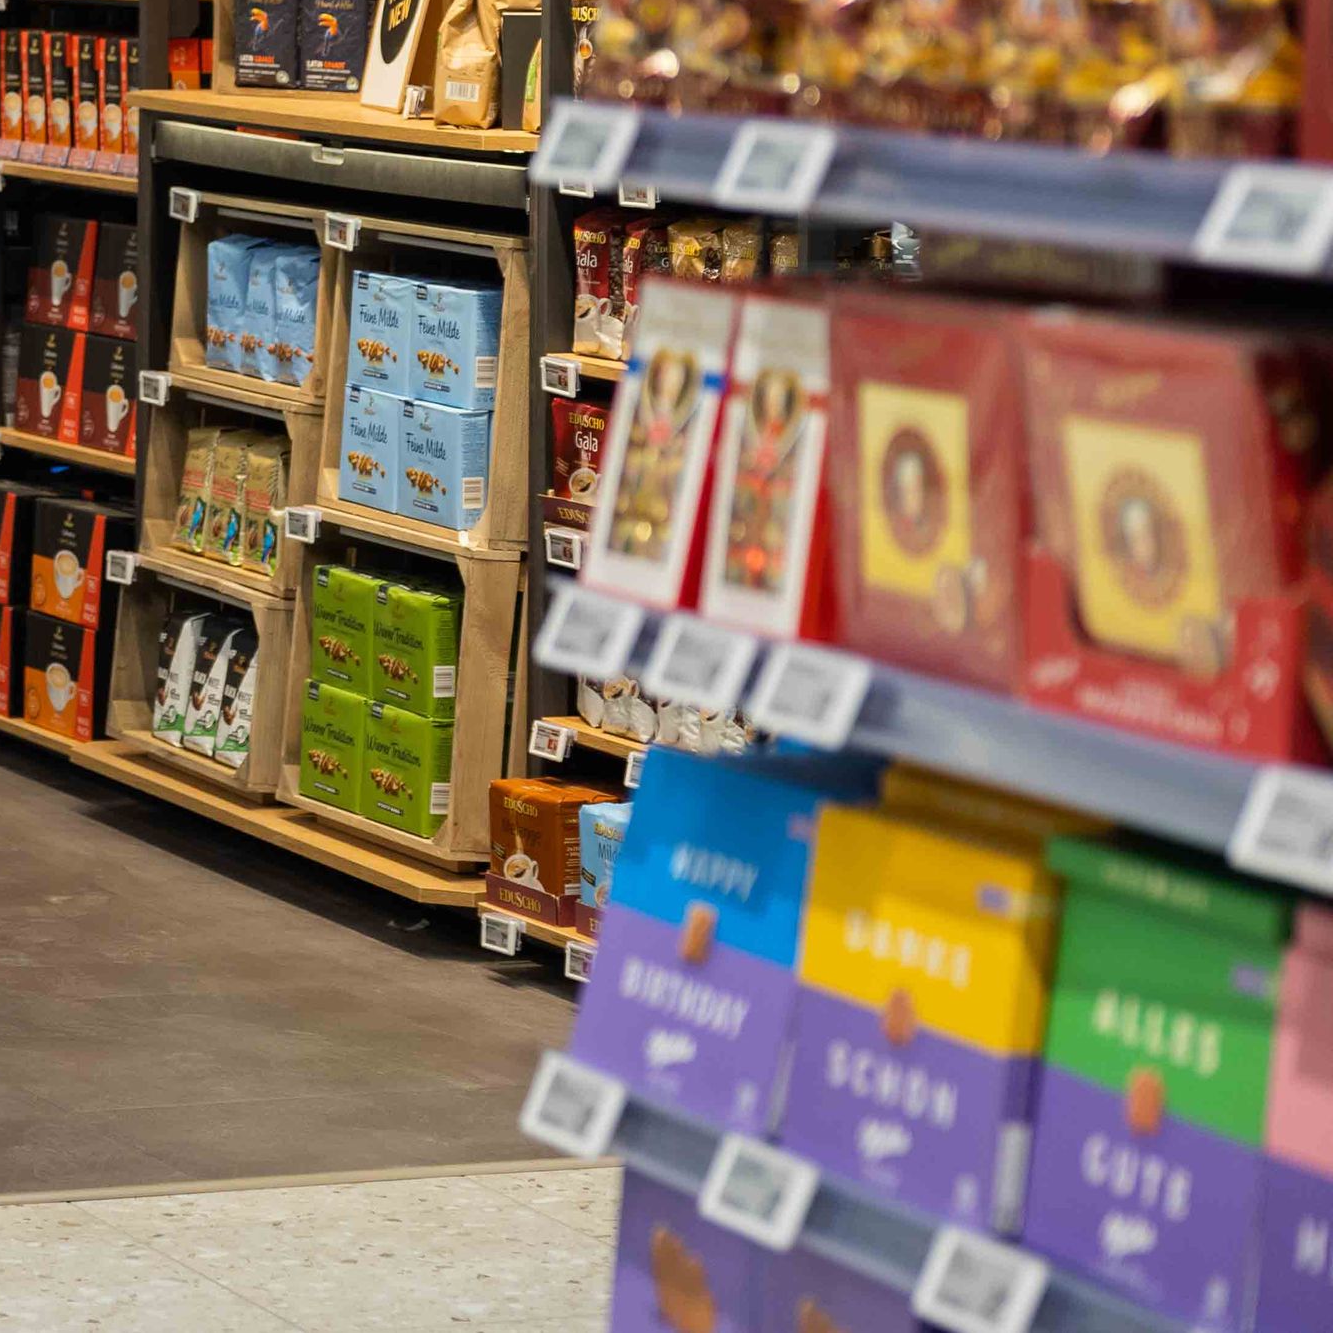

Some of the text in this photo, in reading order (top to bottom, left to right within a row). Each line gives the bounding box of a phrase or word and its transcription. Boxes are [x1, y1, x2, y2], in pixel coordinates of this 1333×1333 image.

[359, 304, 400, 329] Feine Milde
[418, 315, 461, 340] Feine Milde
[350, 416, 389, 444] Feine Milde
[569, 411, 605, 431] EDUSCHO
[405, 432, 447, 460] Feine Milde
[575, 431, 599, 453] Gala
[504, 797, 538, 817] EDUSCHO
[598, 842, 622, 861] Mild
[668, 841, 761, 899] HAPPY
[499, 887, 542, 914] EDUSCHO
[844, 910, 974, 989] DANKE
[618, 958, 751, 1037] BIRTHDAY
[1090, 989, 1226, 1077] ALLES
[1080, 1132, 1193, 1222] GUTE
